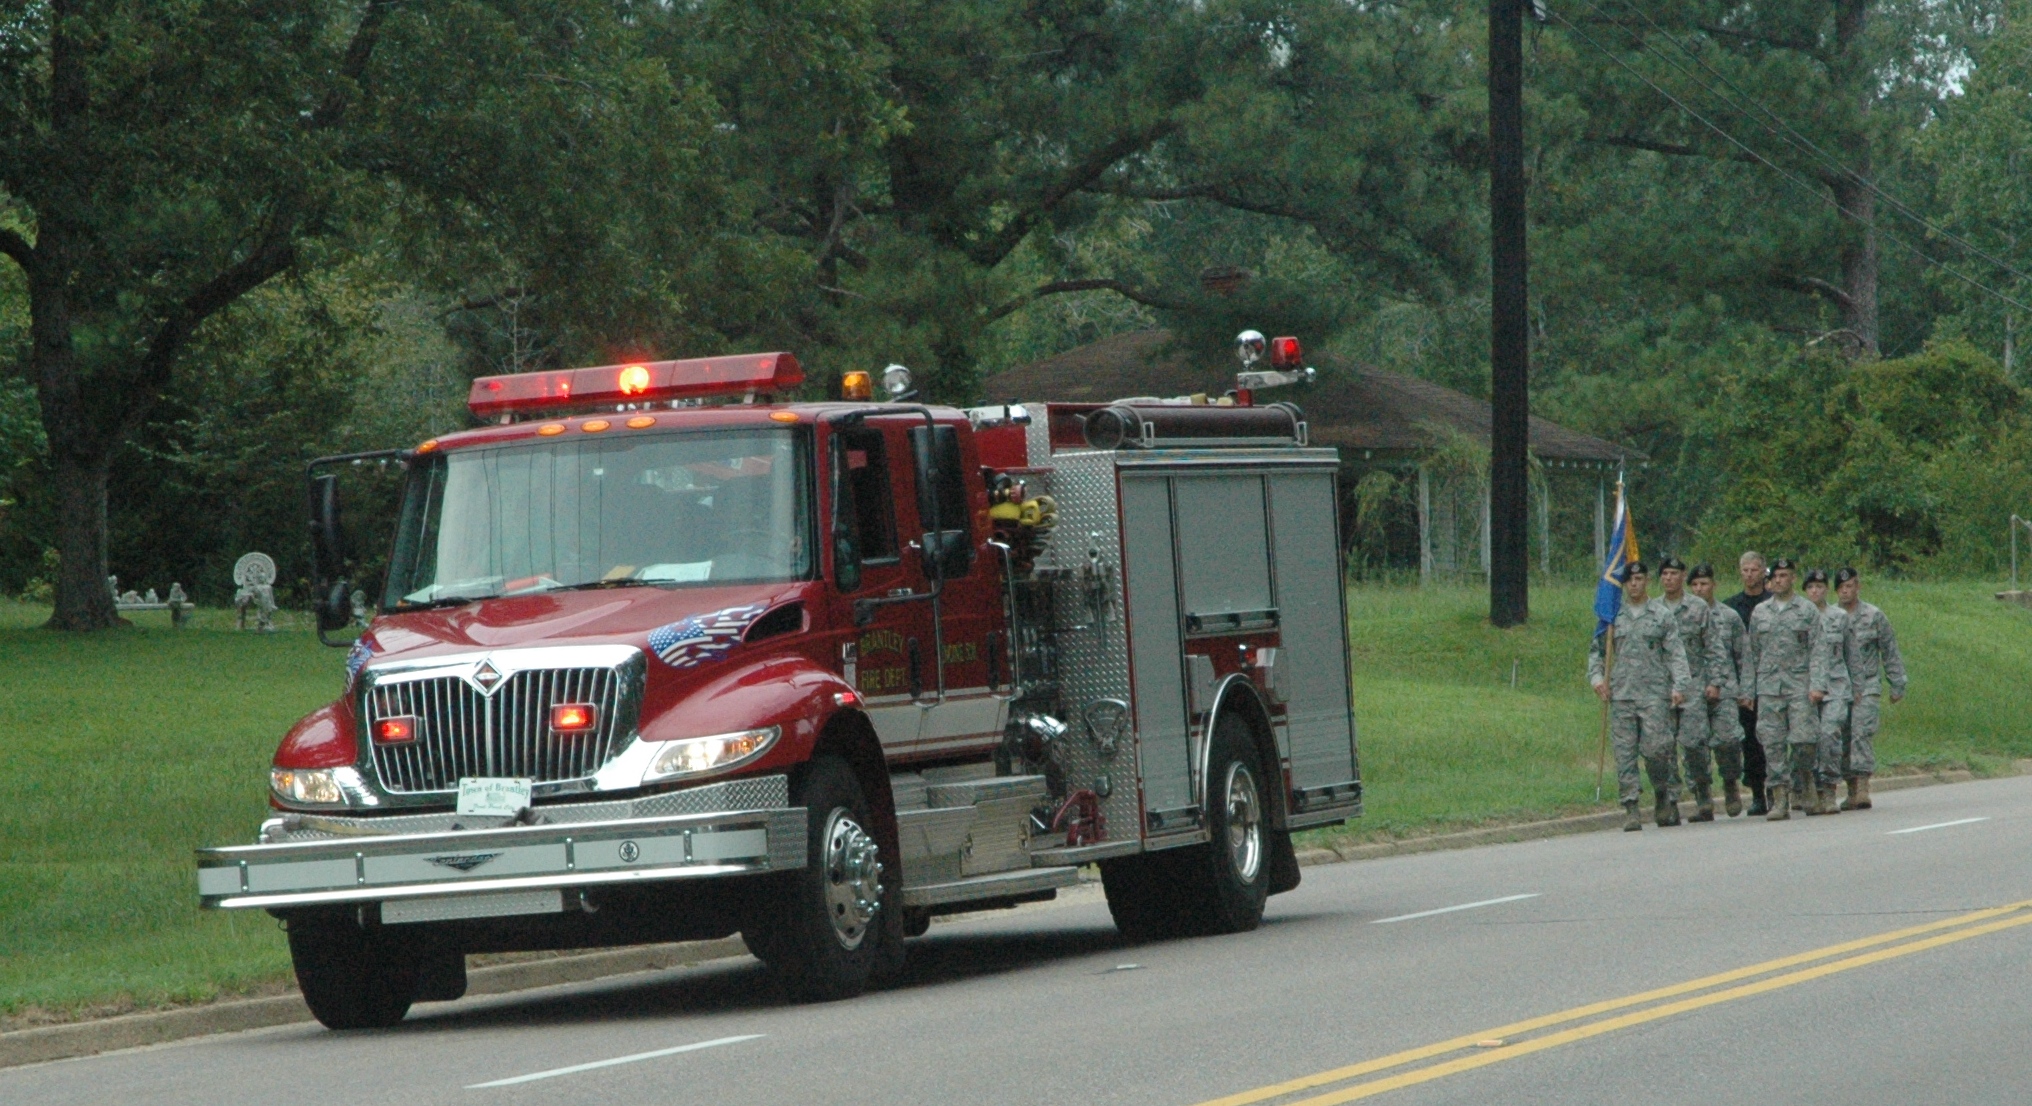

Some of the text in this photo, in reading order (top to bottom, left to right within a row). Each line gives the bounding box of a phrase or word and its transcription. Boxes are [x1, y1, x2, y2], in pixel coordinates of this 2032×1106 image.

[860, 630, 904, 657] BRANTLEY
[861, 669, 882, 690] FIRE
[462, 782, 530, 799] Town of Brantley
